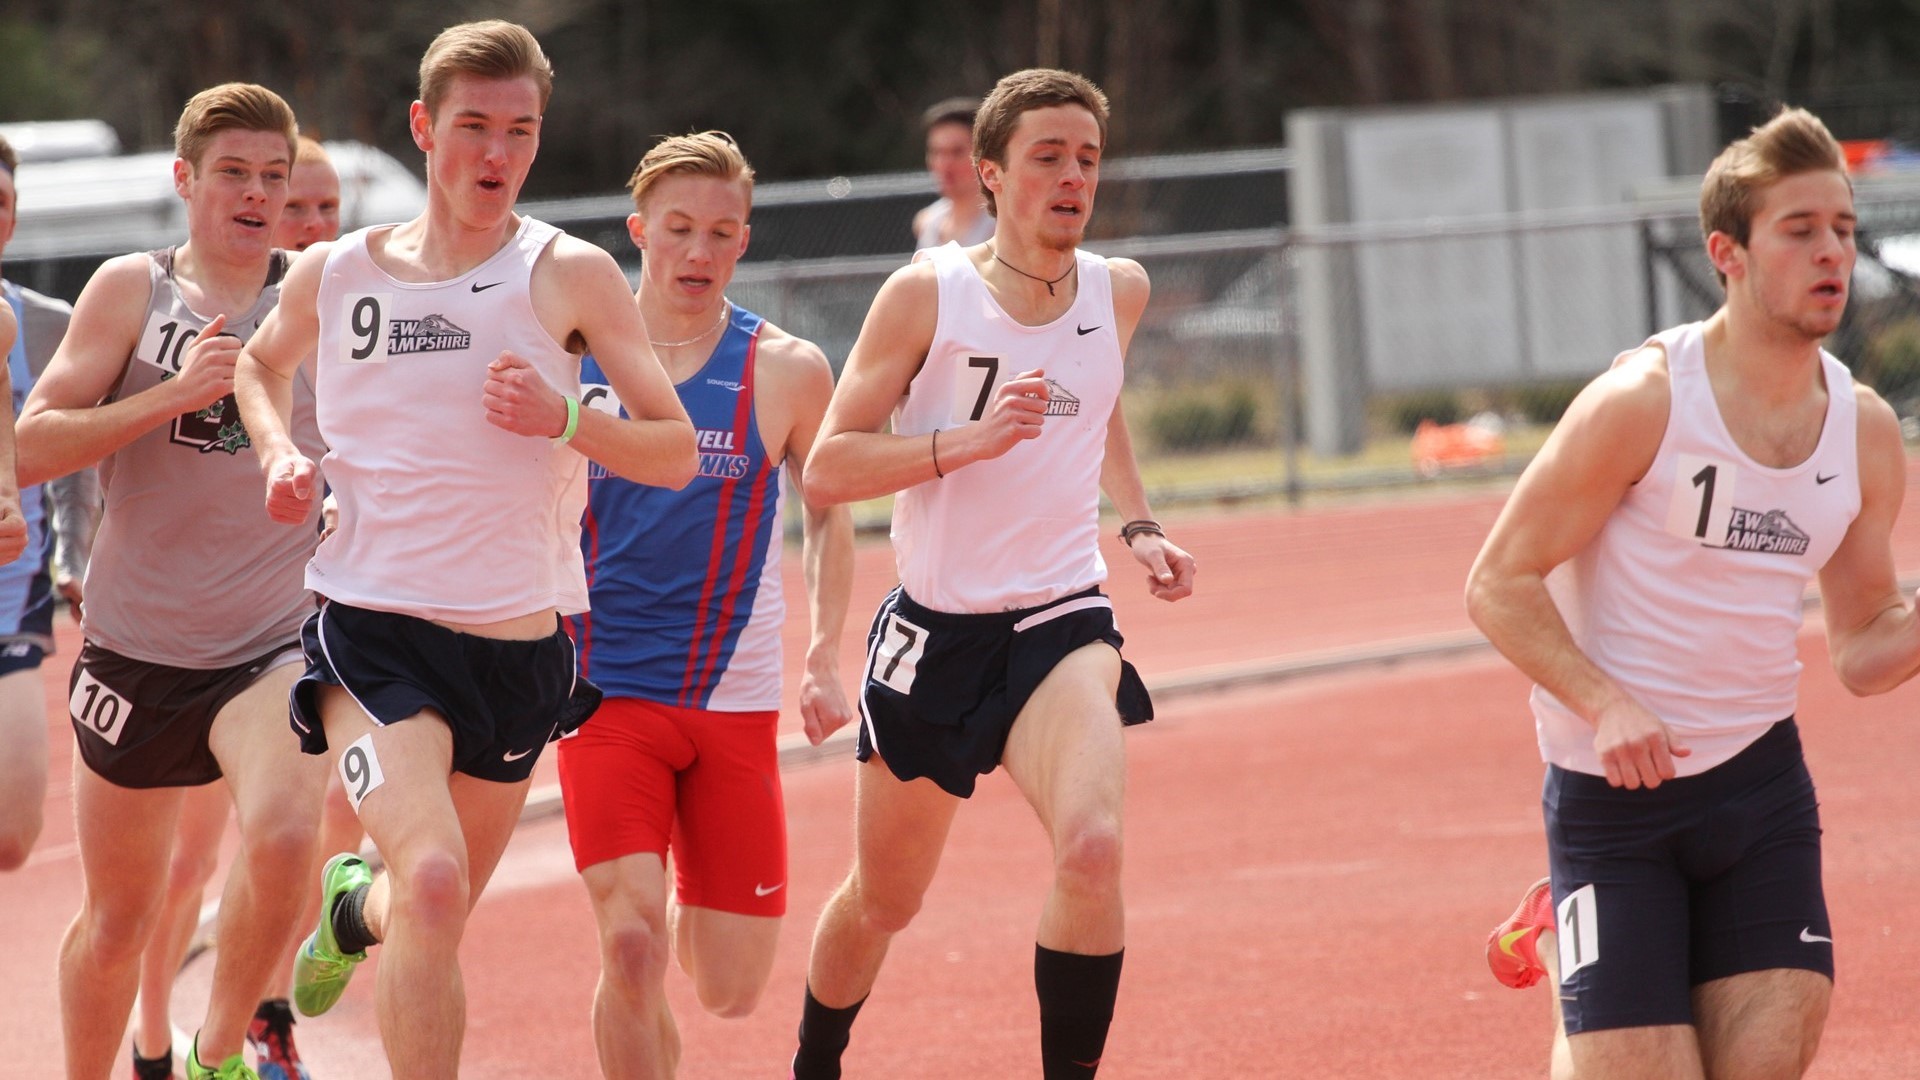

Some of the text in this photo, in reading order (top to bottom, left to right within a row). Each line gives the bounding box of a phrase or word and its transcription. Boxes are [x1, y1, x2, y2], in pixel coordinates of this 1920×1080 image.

[351, 296, 381, 360] 9
[387, 335, 470, 354] AMPSHIRE
[388, 320, 419, 337] EW
[968, 356, 999, 421] 7
[1692, 464, 1717, 538] 1
[1730, 509, 1764, 533] EW
[1726, 528, 1809, 556] AMPSHIRE
[882, 621, 918, 682] 7
[80, 683, 120, 734] 10
[344, 746, 370, 801] 9
[1565, 897, 1582, 966] 1
